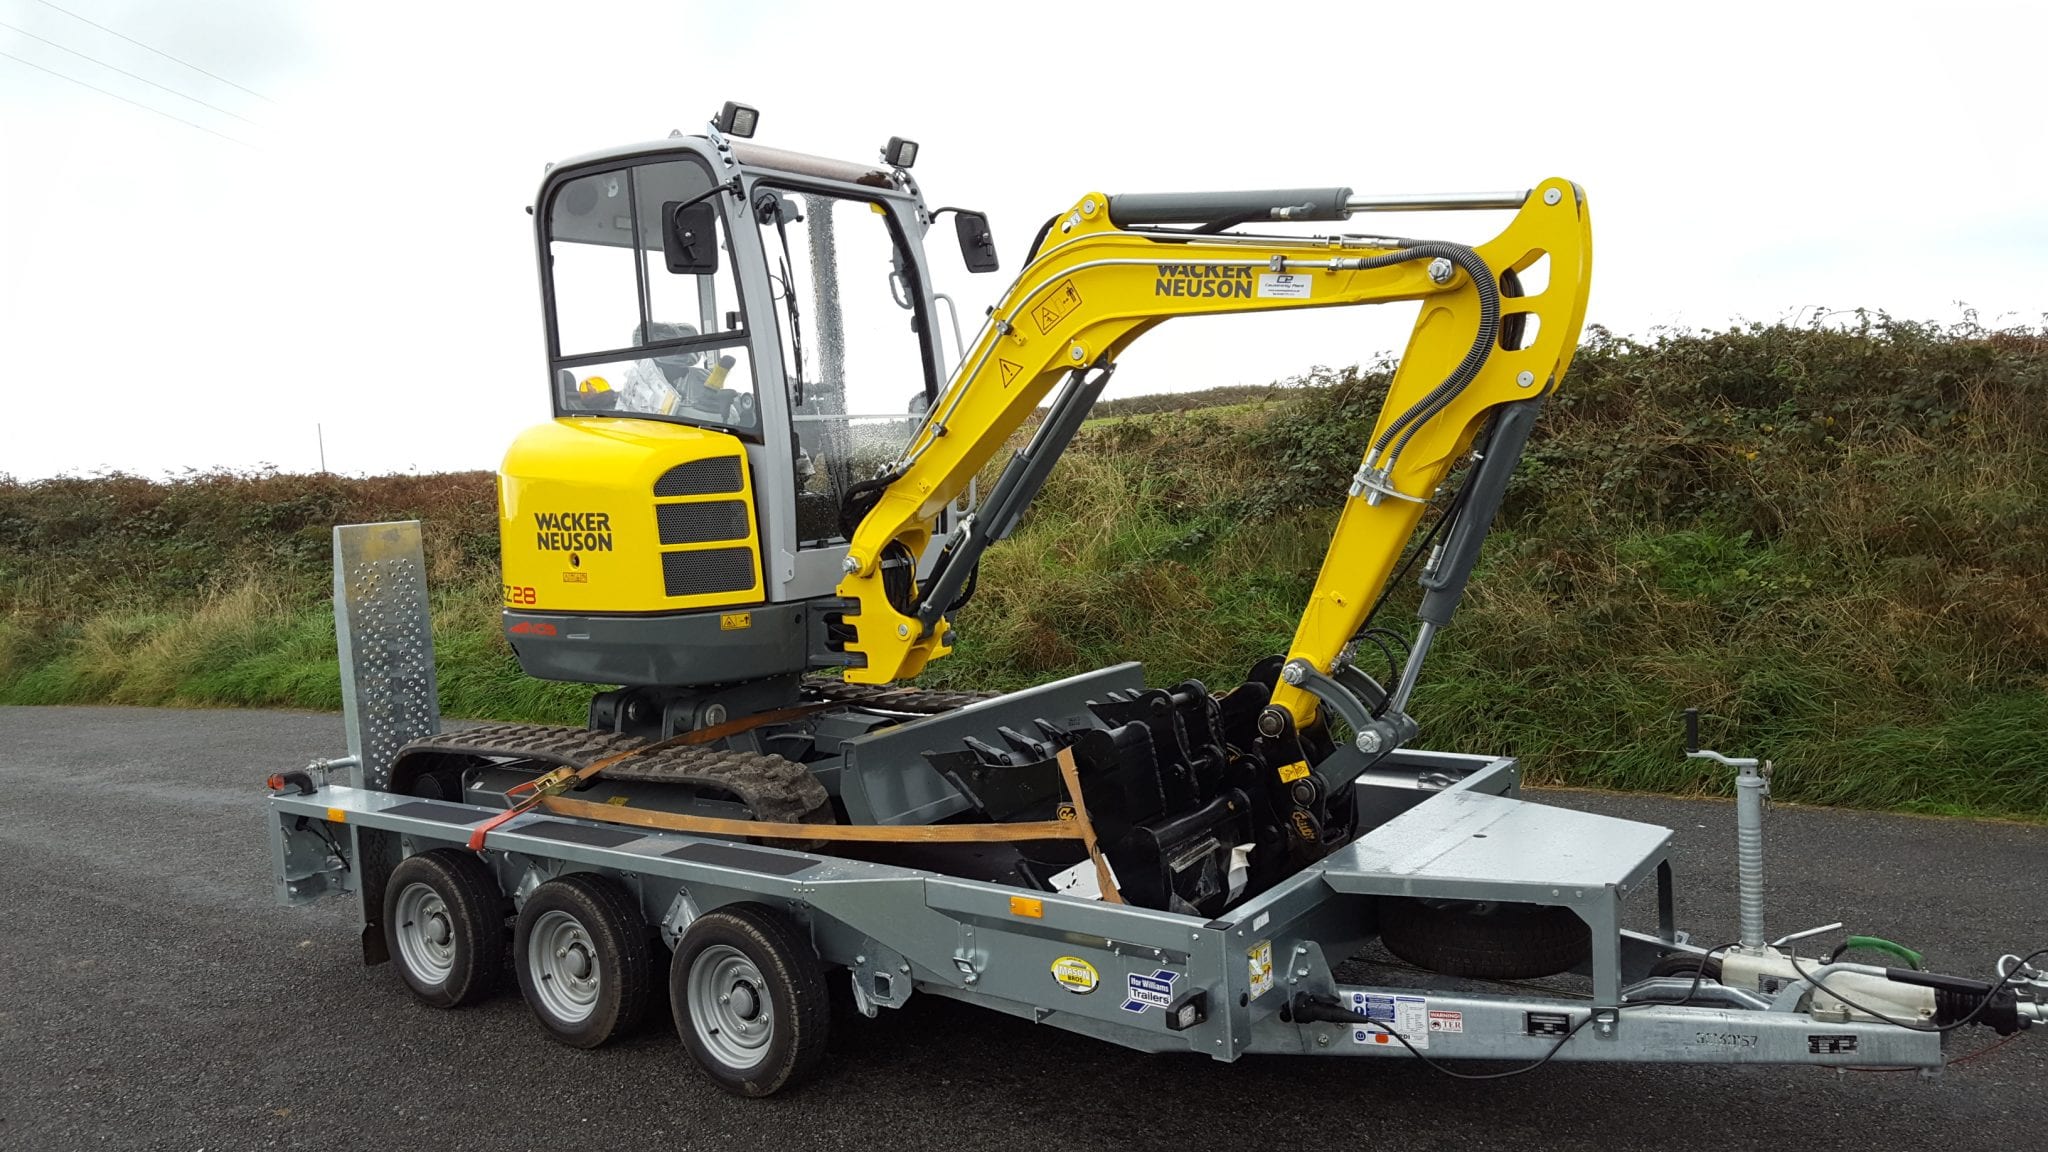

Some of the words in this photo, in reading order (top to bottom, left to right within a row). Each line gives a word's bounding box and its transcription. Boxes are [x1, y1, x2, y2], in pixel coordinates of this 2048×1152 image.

[1157, 265, 1252, 278] WACKER
[1155, 279, 1252, 298] NEUSON
[534, 512, 611, 531] WACKER
[537, 532, 612, 551] NEUSON
[1058, 965, 1090, 979] MASON
[1067, 975, 1083, 983] BROS
[1130, 977, 1141, 986] Ifor
[1142, 979, 1169, 993] Williams
[1131, 988, 1170, 1005] Trailers
